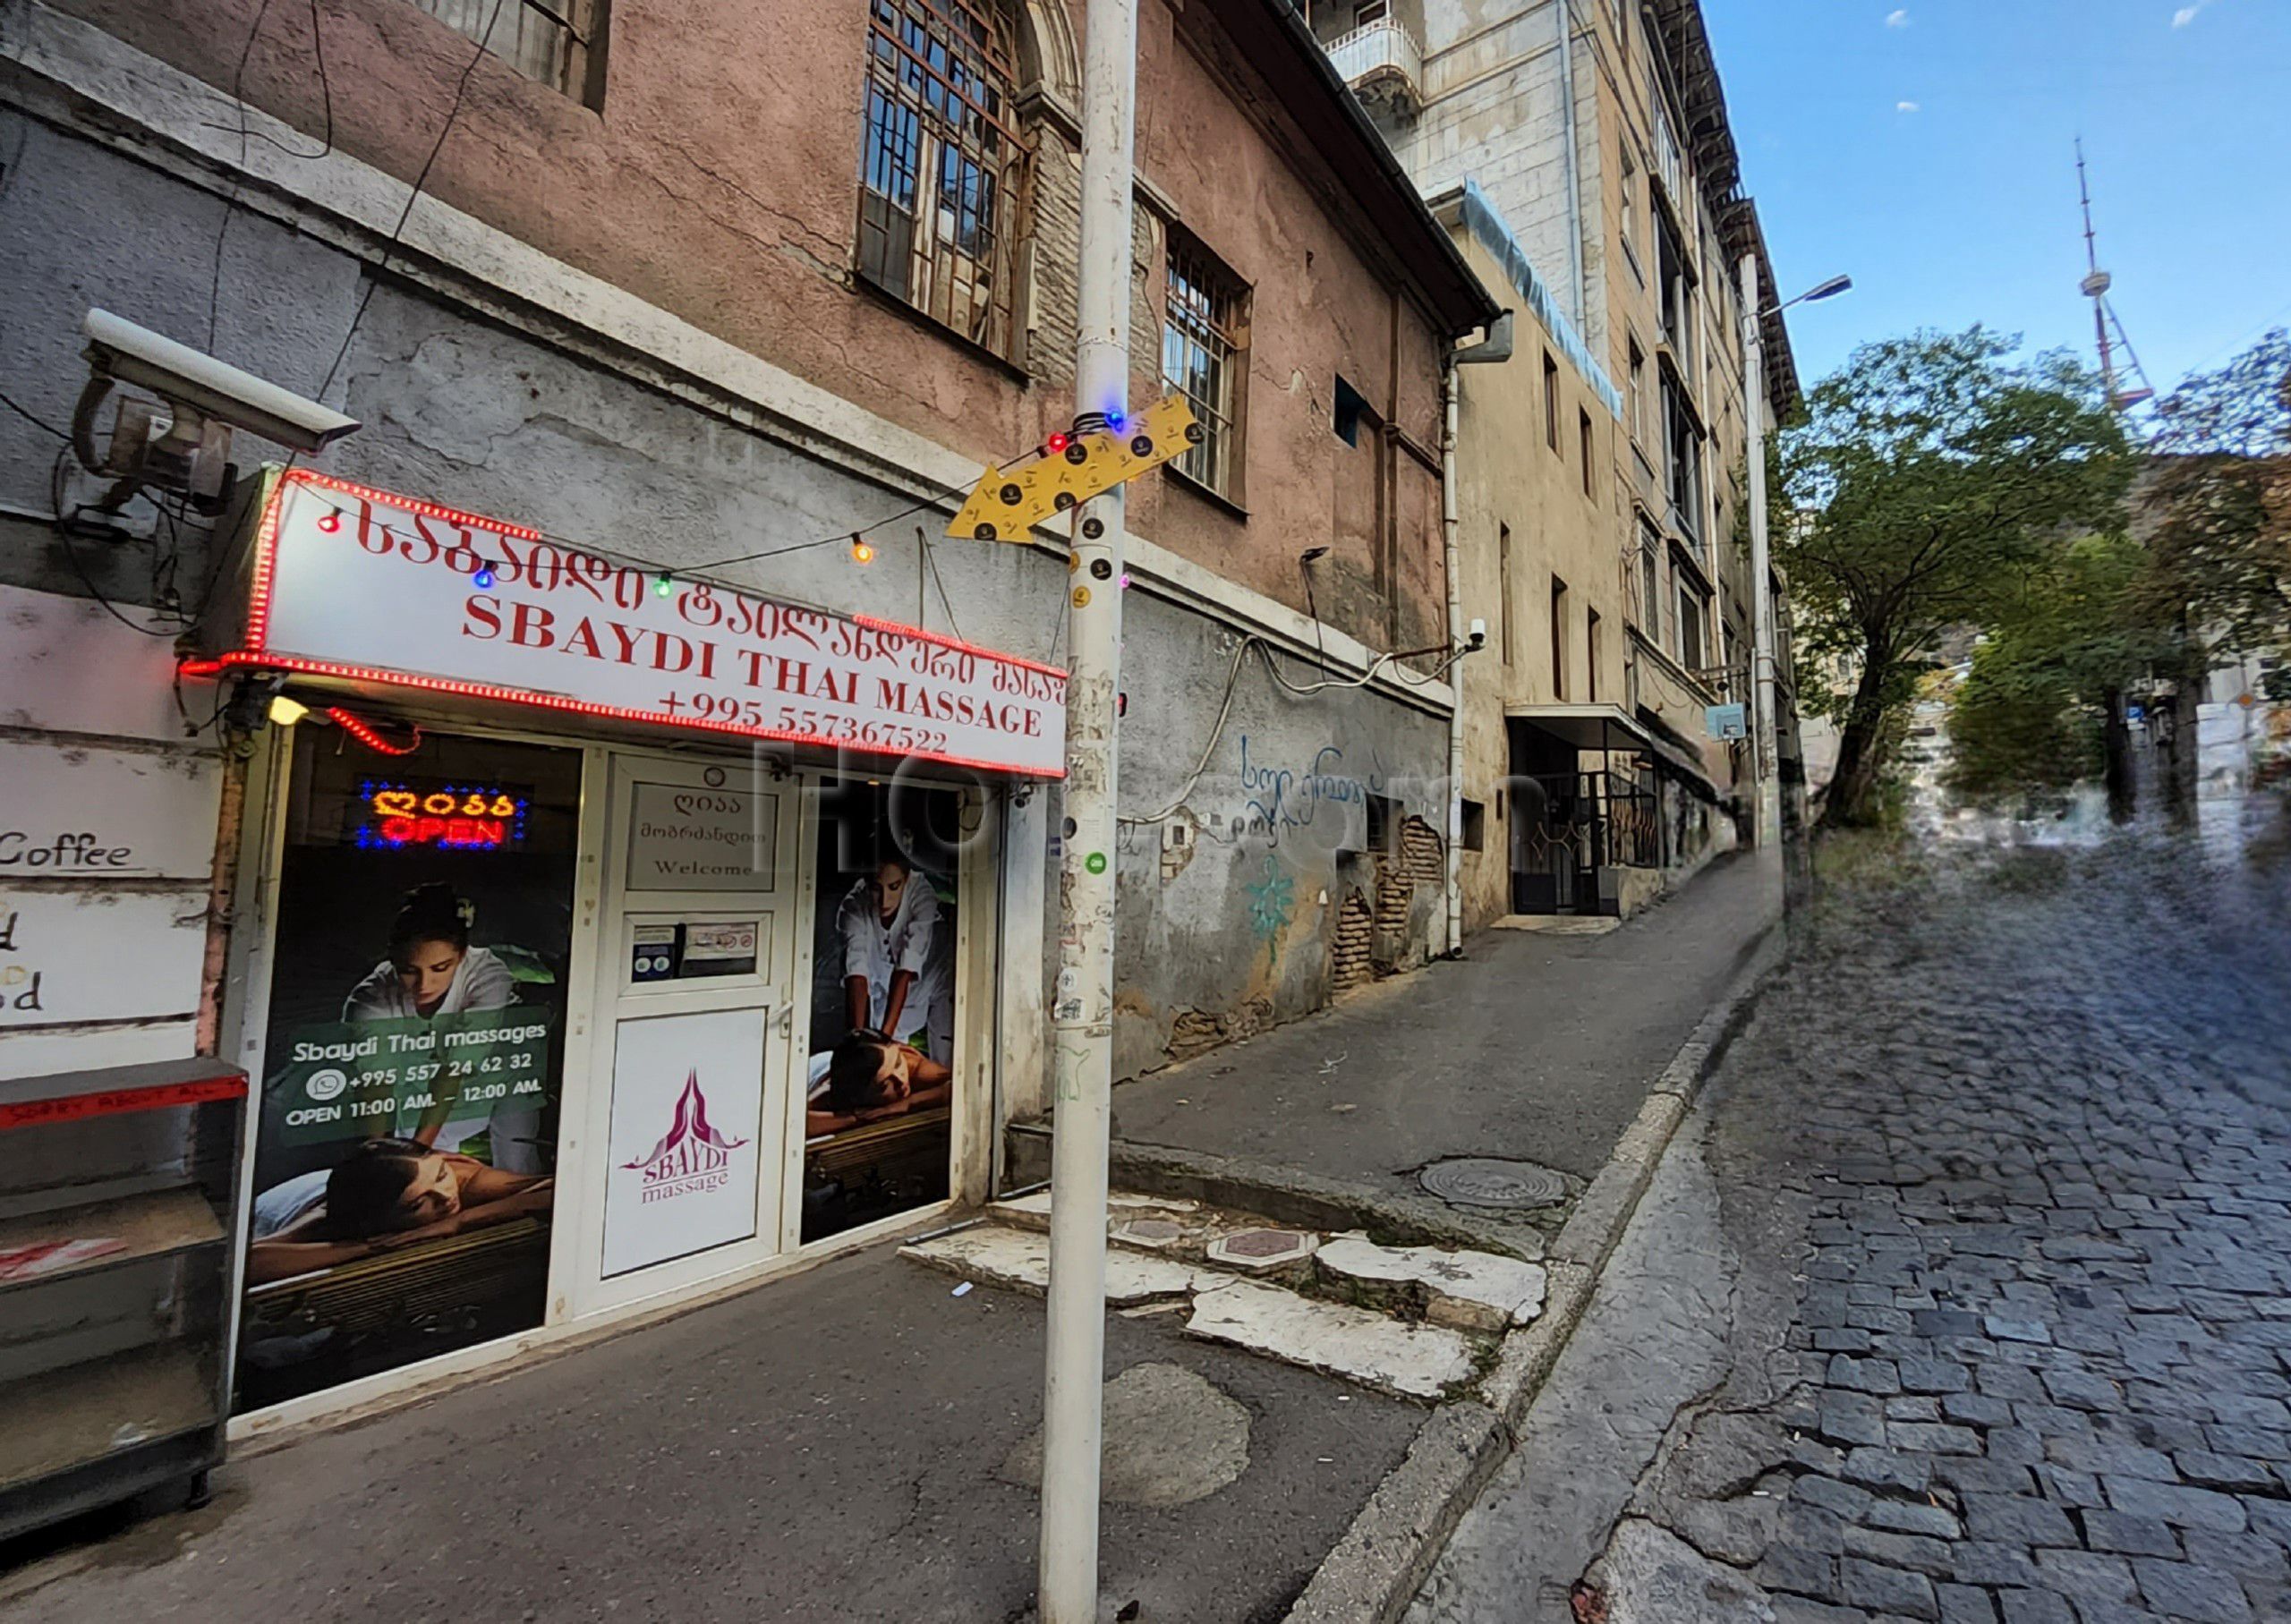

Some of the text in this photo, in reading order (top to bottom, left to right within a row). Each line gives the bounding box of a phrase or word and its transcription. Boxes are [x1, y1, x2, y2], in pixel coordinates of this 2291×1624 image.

[677, 582, 976, 685] ტაილანდური
[462, 594, 1043, 738] SBAYDI THAI MASSAGE
[659, 689, 949, 753] +995 557367522
[673, 794, 742, 817] ღიაა
[0, 831, 132, 866] Coffee
[380, 818, 505, 844] OPEN
[653, 860, 753, 876] Welcome
[292, 1023, 547, 1062] Sbaydi Thai massages
[349, 1053, 532, 1090] +995 557 24 62 32
[285, 1106, 342, 1127] OPEN
[350, 1097, 396, 1118] 11:00
[463, 1084, 507, 1102] 12:00
[643, 1135, 729, 1184] SBAYDI
[641, 1171, 729, 1204] massage
